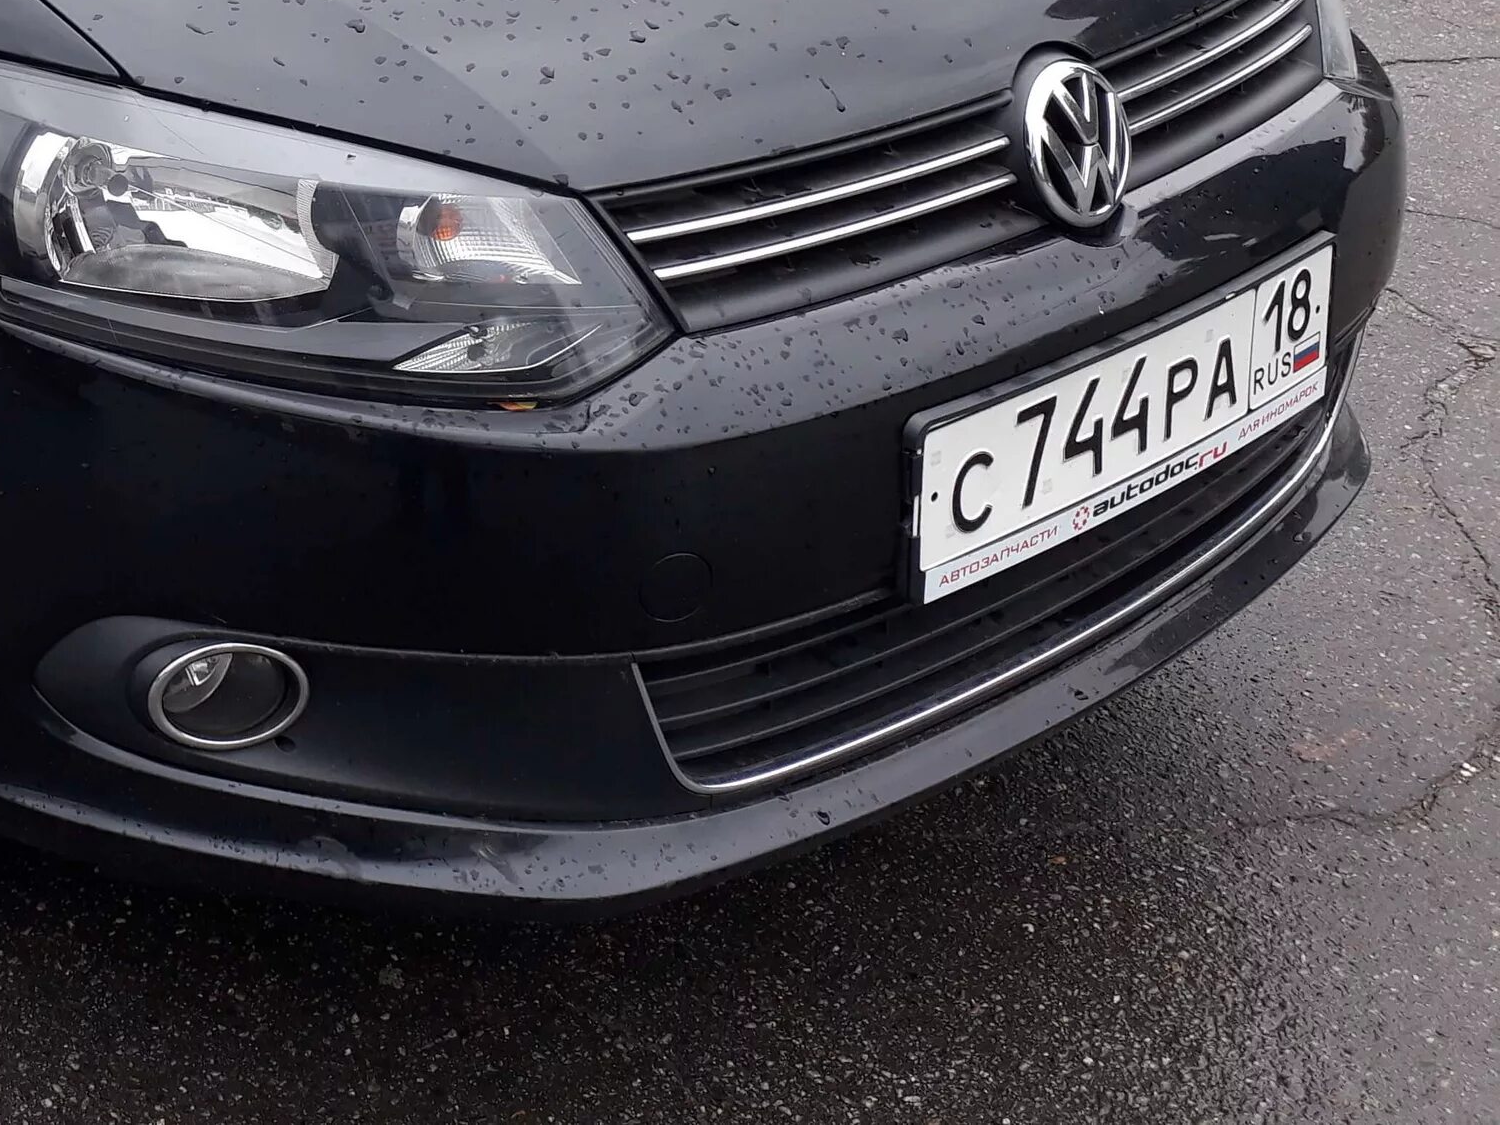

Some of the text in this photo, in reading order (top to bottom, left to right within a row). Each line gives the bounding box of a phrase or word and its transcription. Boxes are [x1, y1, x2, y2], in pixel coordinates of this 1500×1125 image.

[1263, 269, 1311, 354] 18
[1254, 352, 1291, 395] RUS
[939, 526, 1058, 588] АВТОЗАПЧАСТИ
